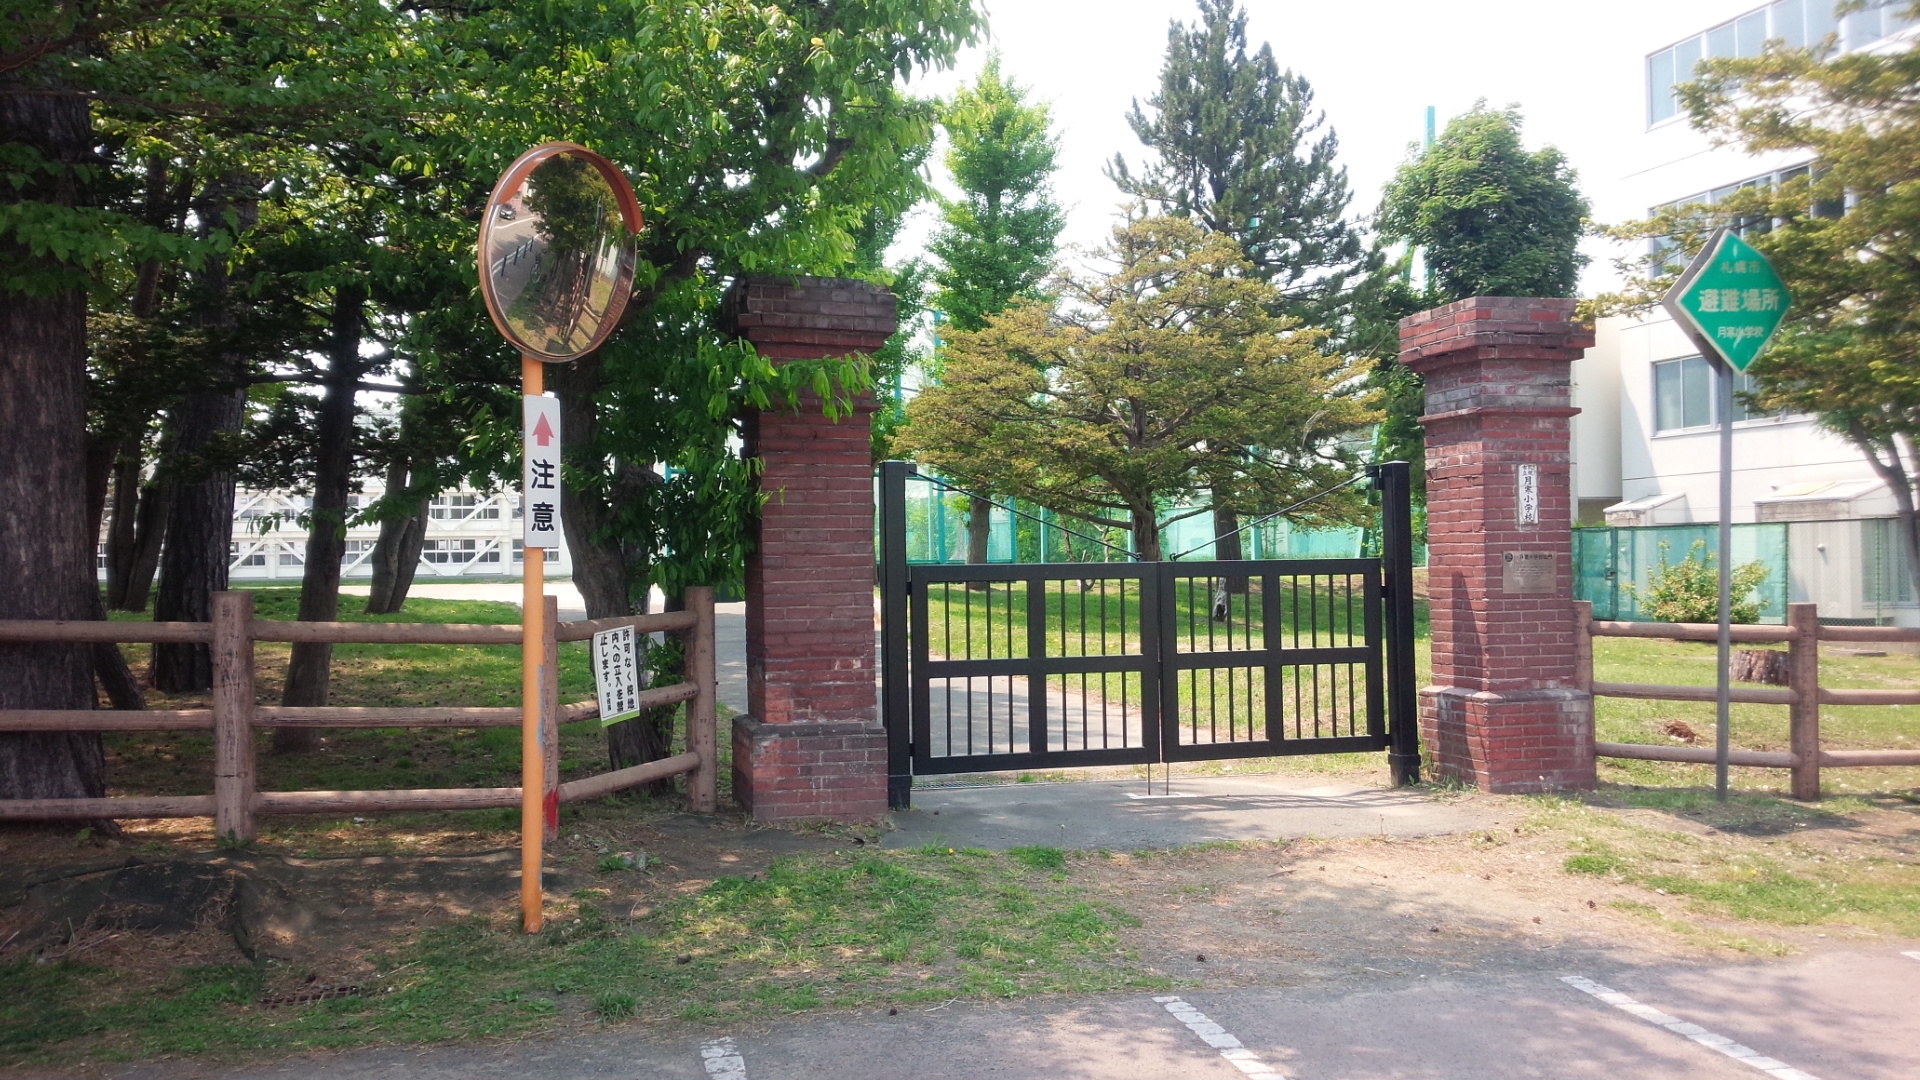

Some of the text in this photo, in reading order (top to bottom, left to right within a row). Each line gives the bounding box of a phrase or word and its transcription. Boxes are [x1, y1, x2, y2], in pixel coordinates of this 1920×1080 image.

[1719, 260, 1761, 274] 札幌市
[1698, 288, 1779, 313] 避難場所
[1717, 326, 1764, 340] 月寒小学校
[531, 458, 555, 531] 注意
[1523, 475, 1534, 522] 月寒小学校
[611, 631, 624, 713] 内への立入を禁
[622, 628, 635, 709] 許可なく校地
